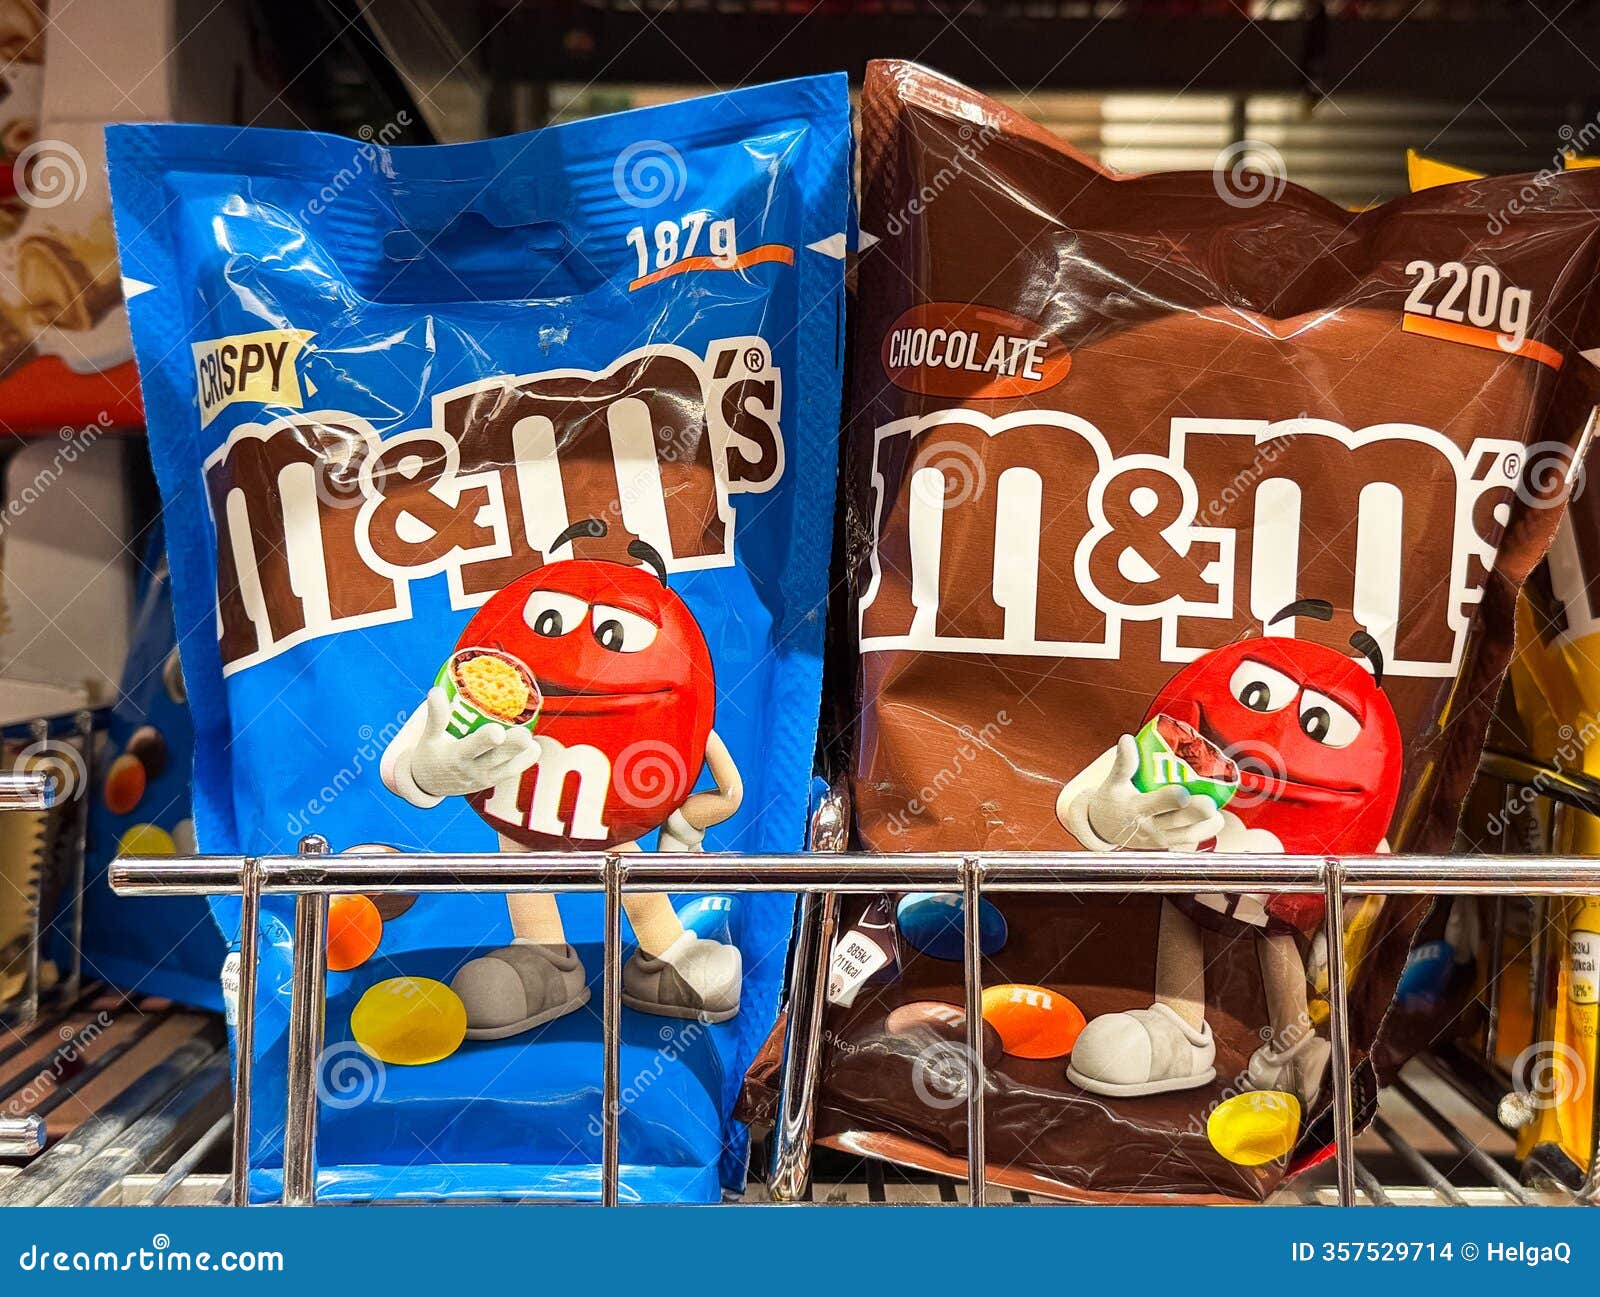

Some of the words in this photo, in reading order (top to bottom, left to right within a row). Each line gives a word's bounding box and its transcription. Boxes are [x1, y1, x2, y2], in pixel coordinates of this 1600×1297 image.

[626, 210, 738, 279] 187g
[1404, 260, 1533, 353] 220g
[199, 341, 289, 409] CRISPY
[889, 327, 1048, 381] CHOCOLATE
[834, 954, 863, 980] 211kcal
[846, 942, 872, 965] 885kJ
[1010, 988, 1053, 1010] m
